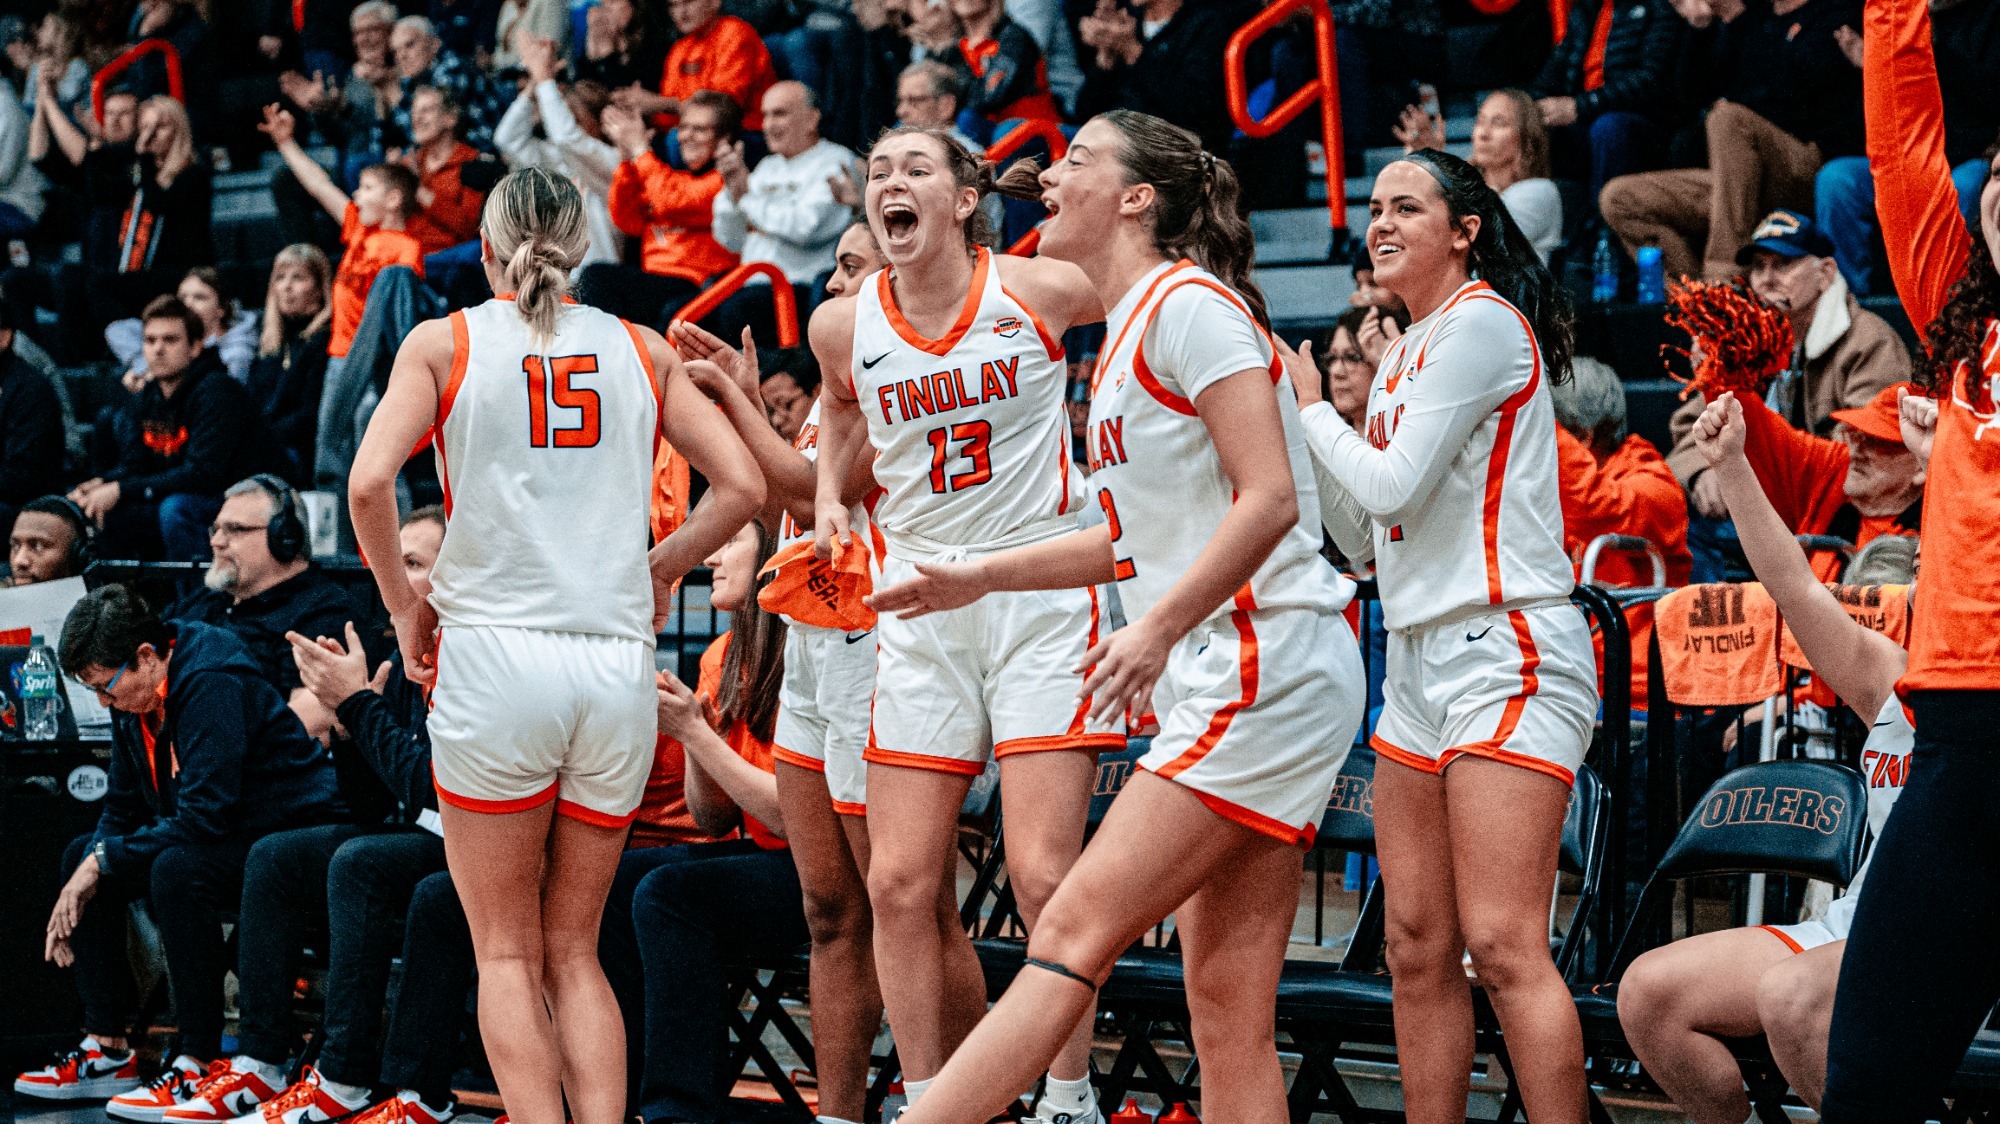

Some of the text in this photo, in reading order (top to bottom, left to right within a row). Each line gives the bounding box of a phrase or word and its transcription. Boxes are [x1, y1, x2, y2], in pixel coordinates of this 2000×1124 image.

[522, 354, 602, 448] 15
[878, 356, 1020, 425] FINDLAY
[927, 419, 993, 494] 13
[1683, 626, 1755, 654] FINDLAY
[1701, 787, 1845, 835] OILERS
